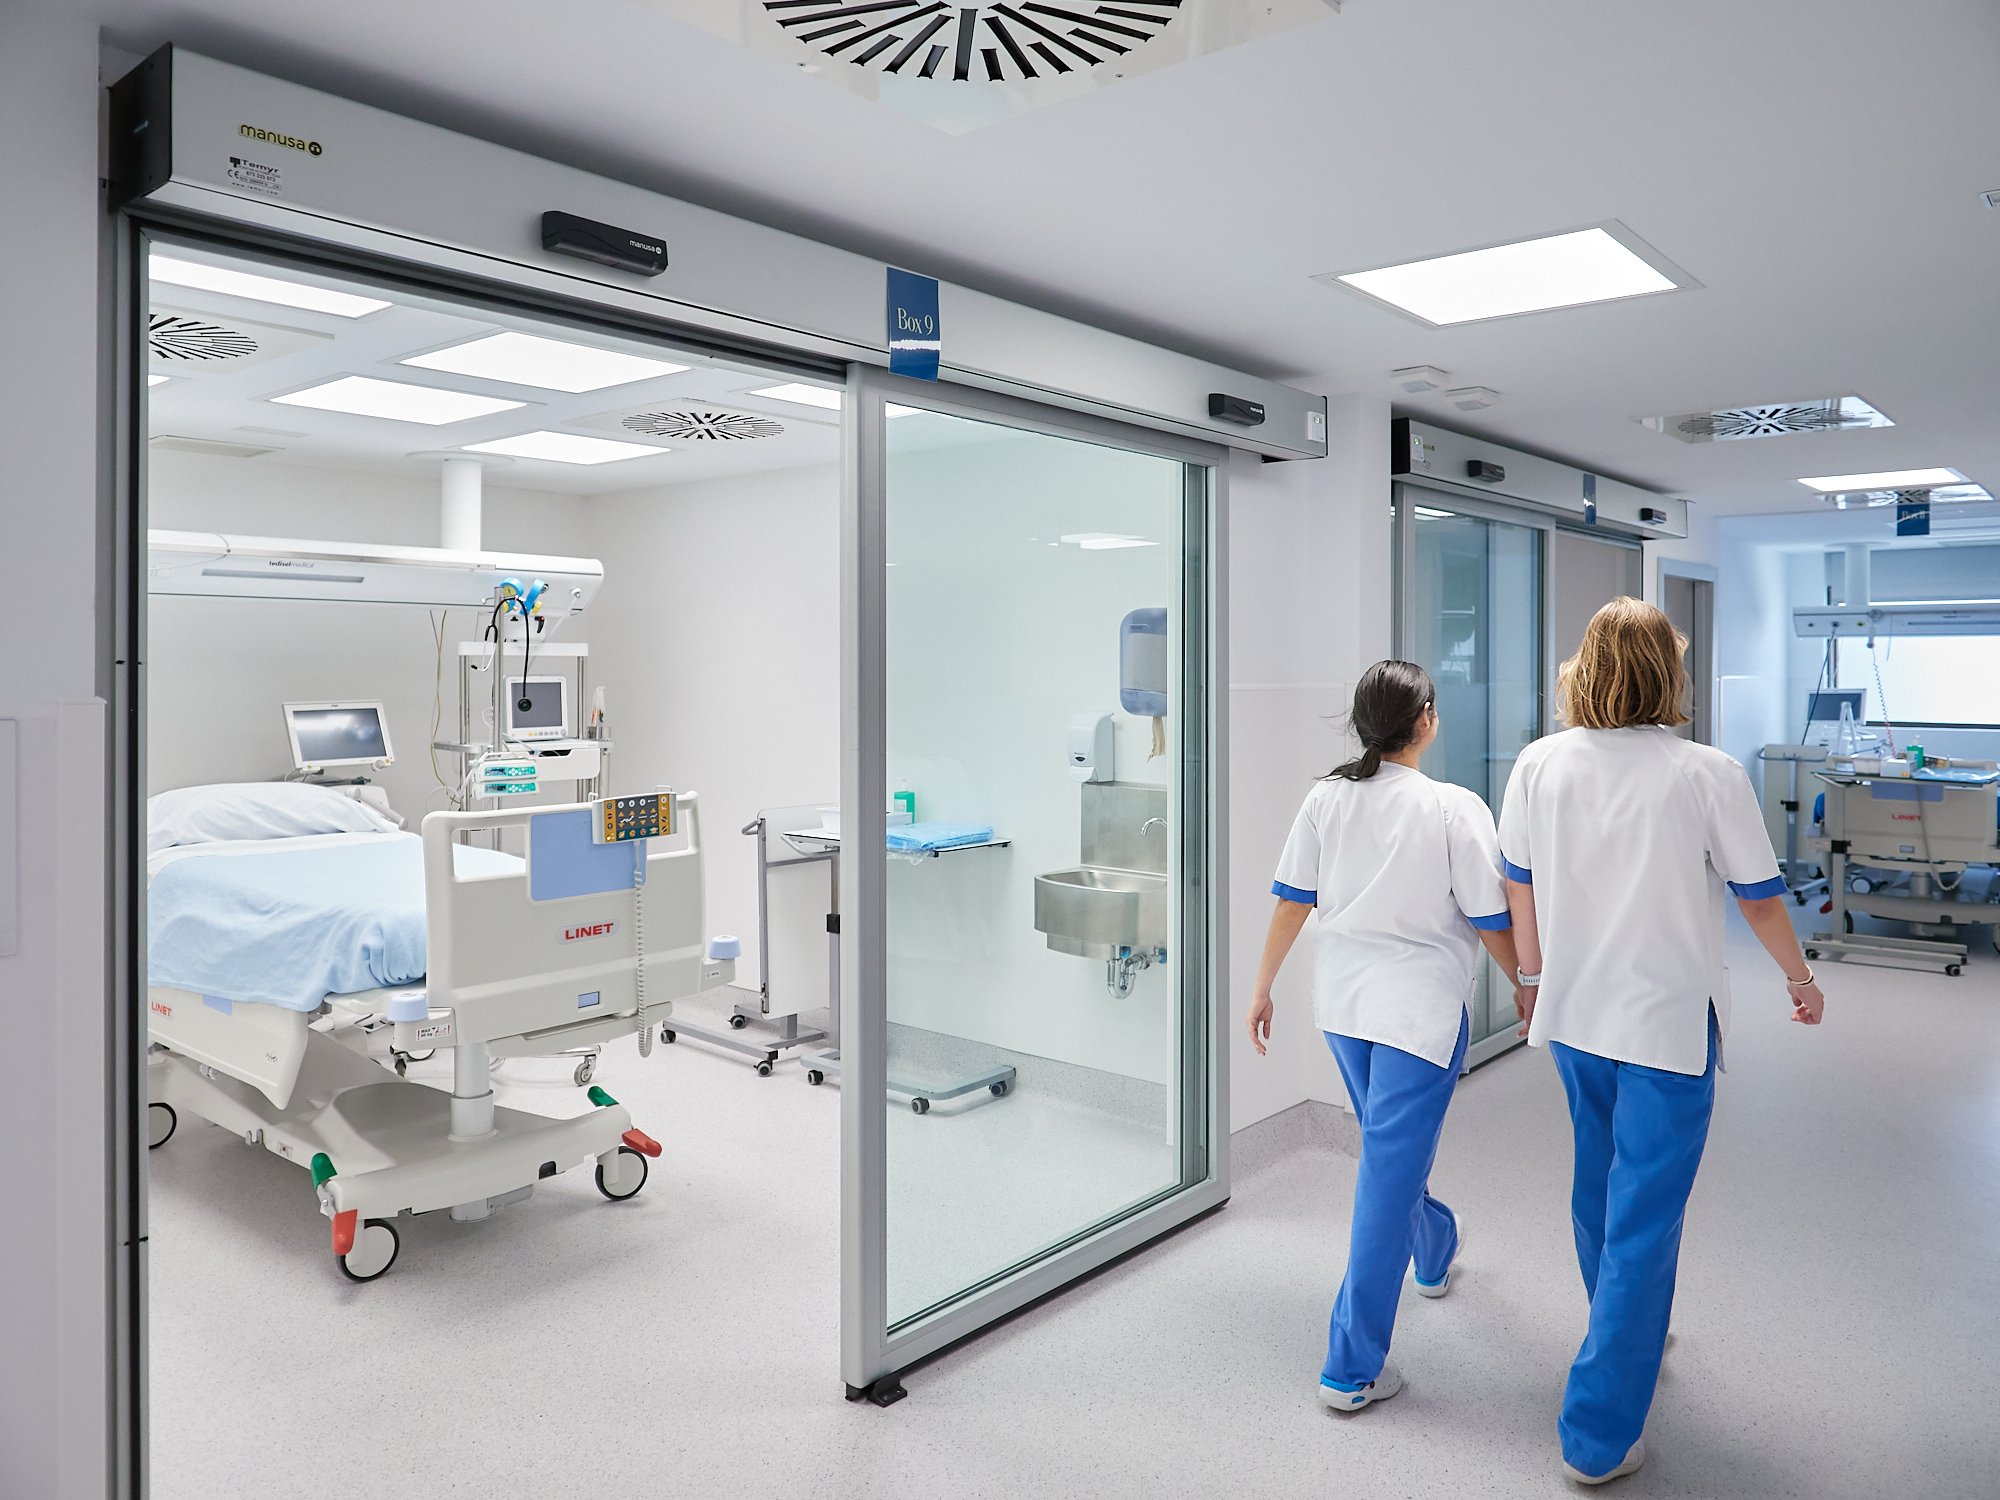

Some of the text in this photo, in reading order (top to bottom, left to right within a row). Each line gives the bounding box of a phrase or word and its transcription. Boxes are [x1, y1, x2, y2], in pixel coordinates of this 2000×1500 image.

[240, 124, 305, 151] manusa
[241, 159, 279, 173] Temyr
[630, 240, 656, 252] manusa
[897, 307, 934, 335] Box 9
[565, 922, 614, 940] LINET
[151, 1001, 172, 1017] LINET
